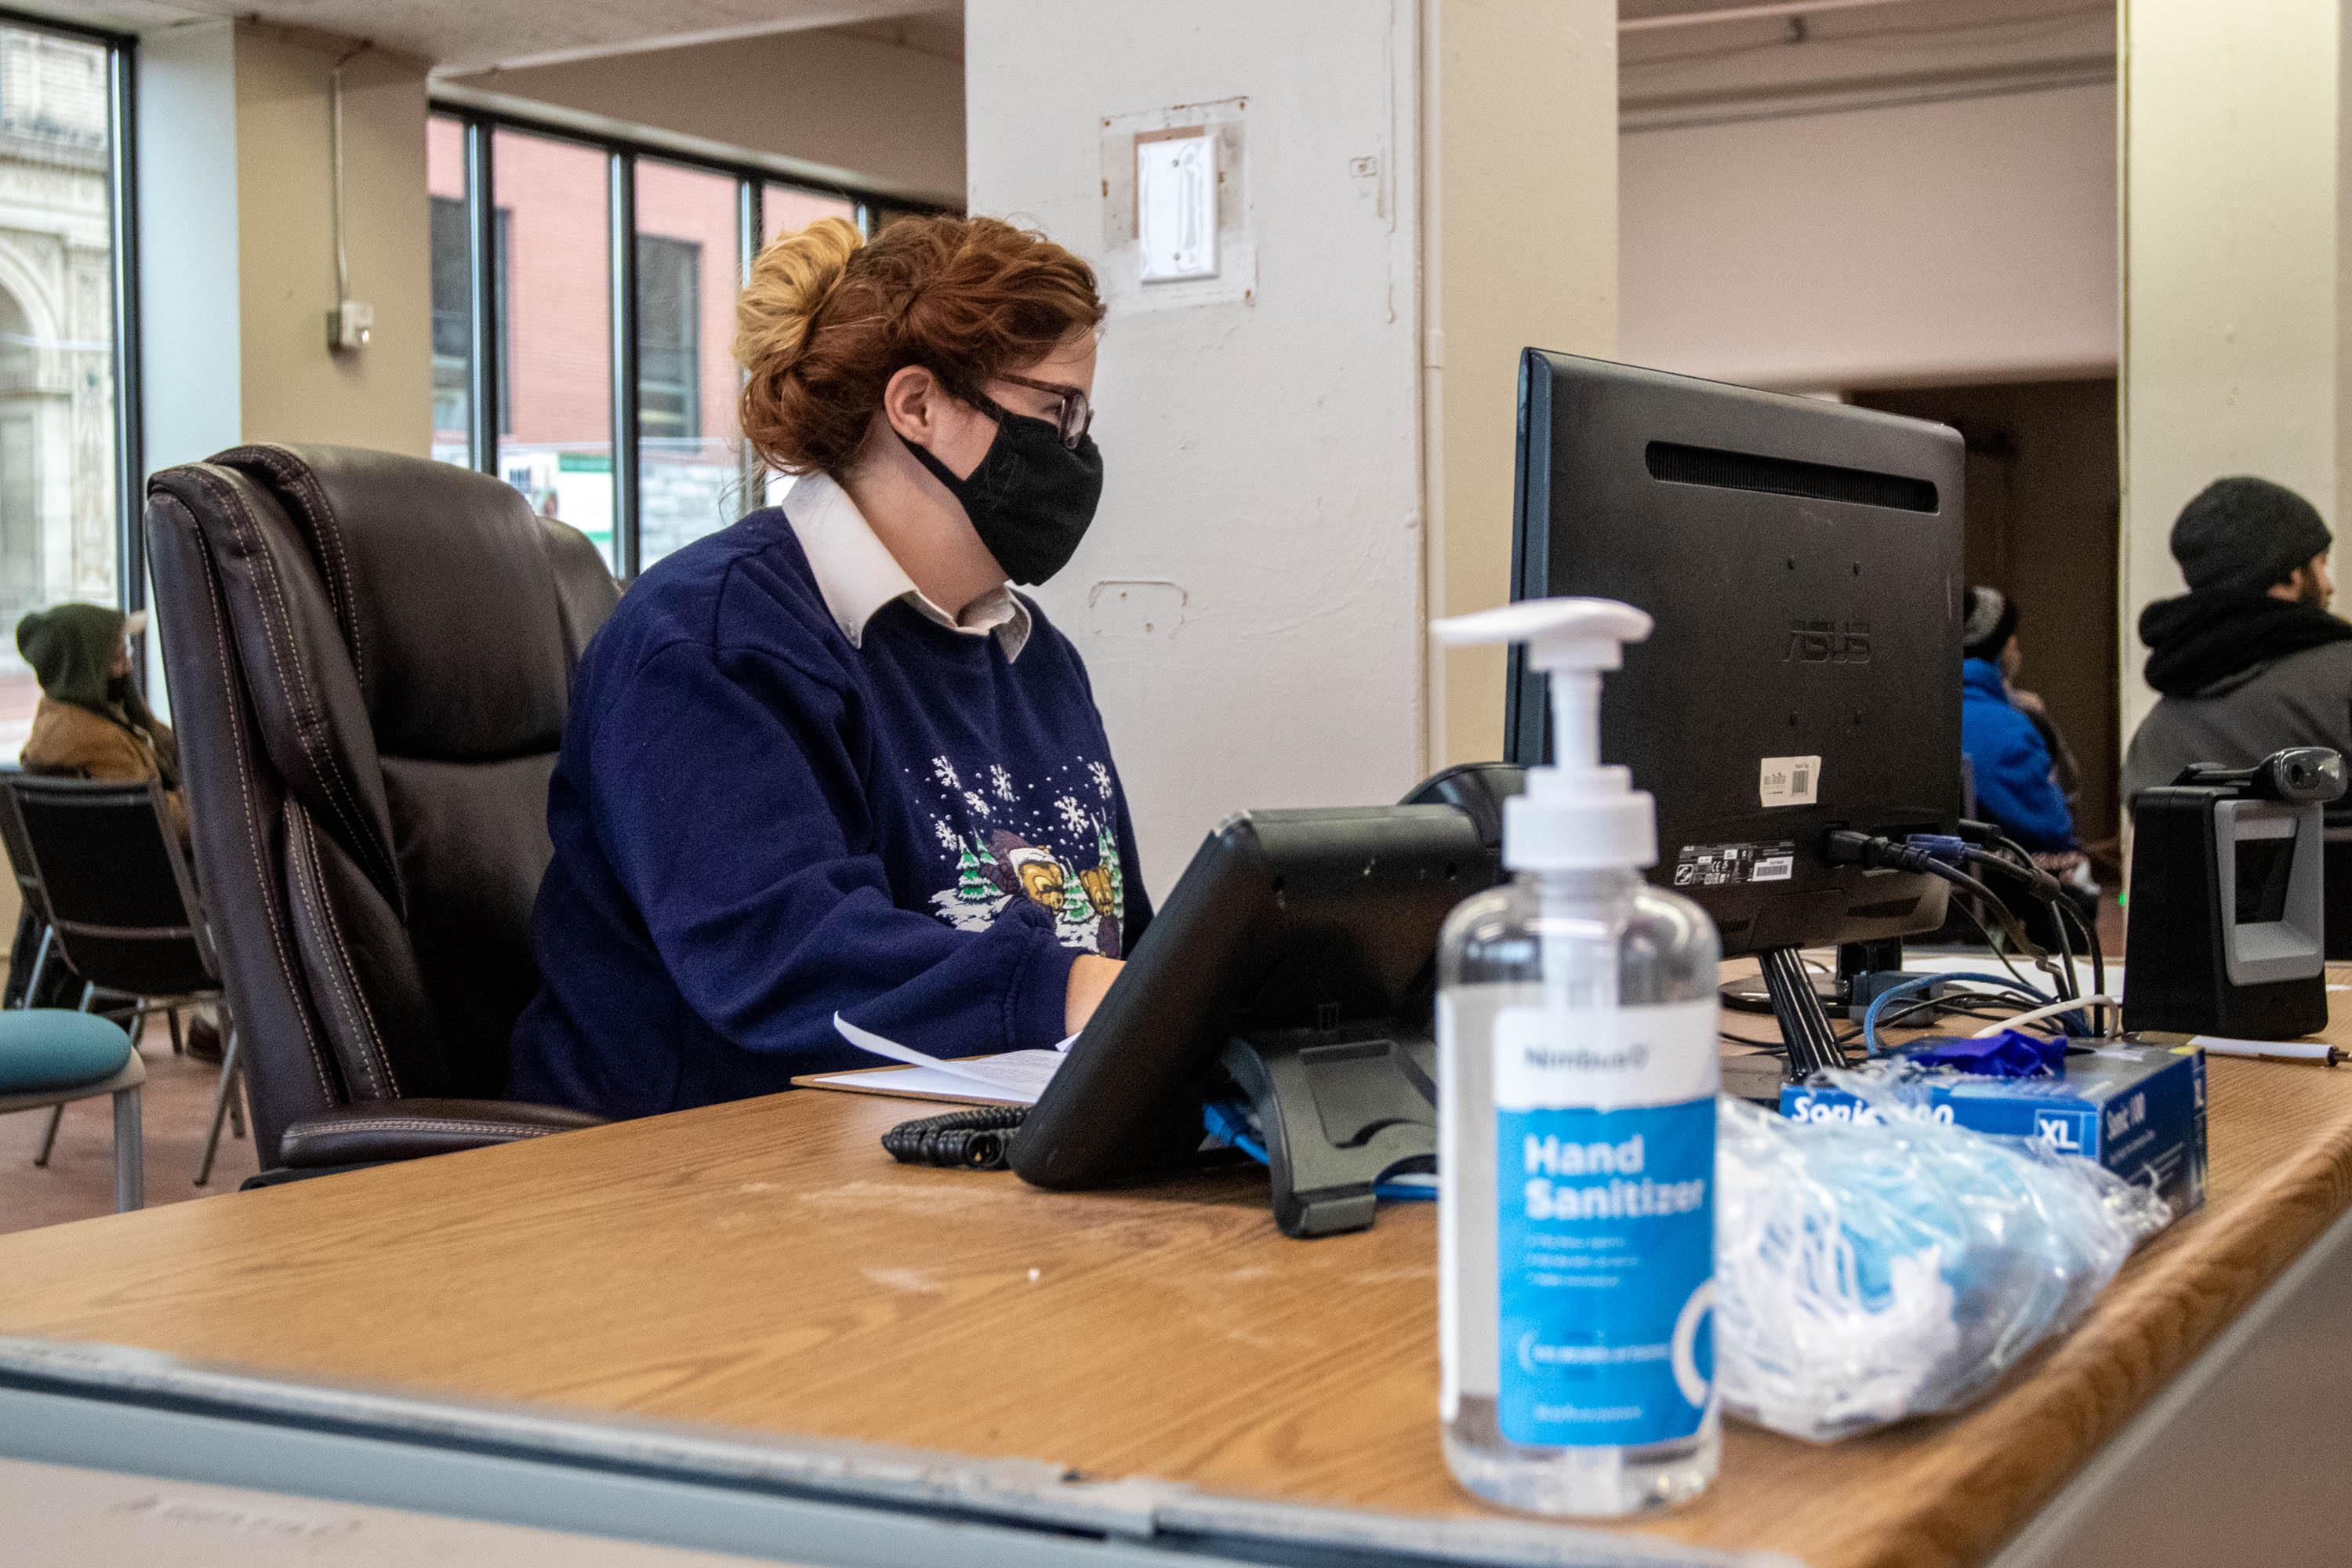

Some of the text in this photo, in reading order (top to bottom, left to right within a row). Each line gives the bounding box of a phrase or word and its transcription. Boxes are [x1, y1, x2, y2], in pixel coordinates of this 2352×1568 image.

[1524, 1134, 1644, 1174] Hand
[2039, 1119, 2079, 1149] XL
[1525, 1178, 1704, 1220] Sanitizer
